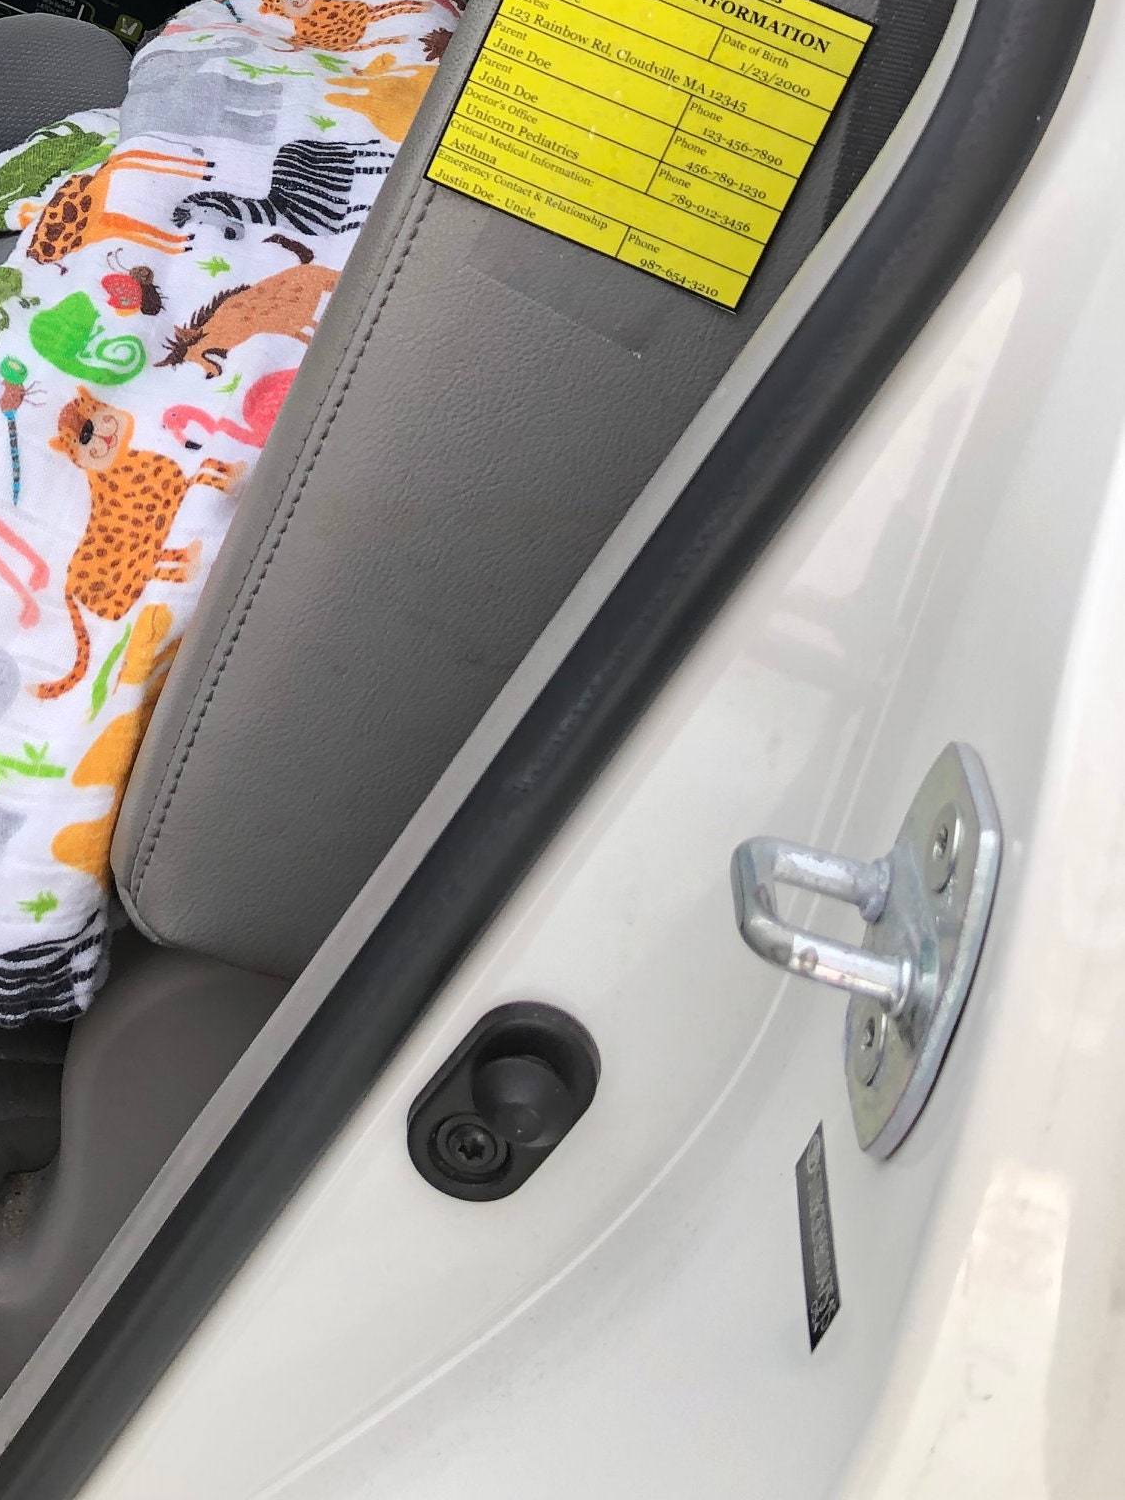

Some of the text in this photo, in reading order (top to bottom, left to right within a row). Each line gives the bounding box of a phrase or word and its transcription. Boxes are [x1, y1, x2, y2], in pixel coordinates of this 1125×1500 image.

[493, 19, 528, 41] Parent
[478, 52, 513, 75] Parent
[492, 37, 552, 70] Jane Doe
[508, 6, 748, 113] 123 Rainbow Rd, Cloudville MA 12345
[721, 33, 789, 69] Date of Birth
[478, 70, 539, 104] John Doe
[739, 62, 811, 98] 1/23/2000
[463, 85, 538, 125] Doctor's Office
[689, 101, 723, 123] Phone
[465, 102, 580, 160] Unicorn Pediatrics
[673, 135, 707, 156] Phone
[702, 127, 783, 167] 123-456-7890
[449, 137, 497, 166] Asthma
[449, 119, 595, 188] Critical Medical Information:
[434, 168, 470, 191] Justin
[471, 183, 495, 201] Doe
[504, 197, 537, 219] Uncle
[436, 148, 608, 231] Emergency Contact & Relationship
[657, 168, 692, 189] Phone
[685, 161, 767, 200] 456-789-1230
[671, 193, 751, 233] 789-012-3456
[627, 233, 661, 254] Phone
[639, 258, 719, 297] 987-654-3210
